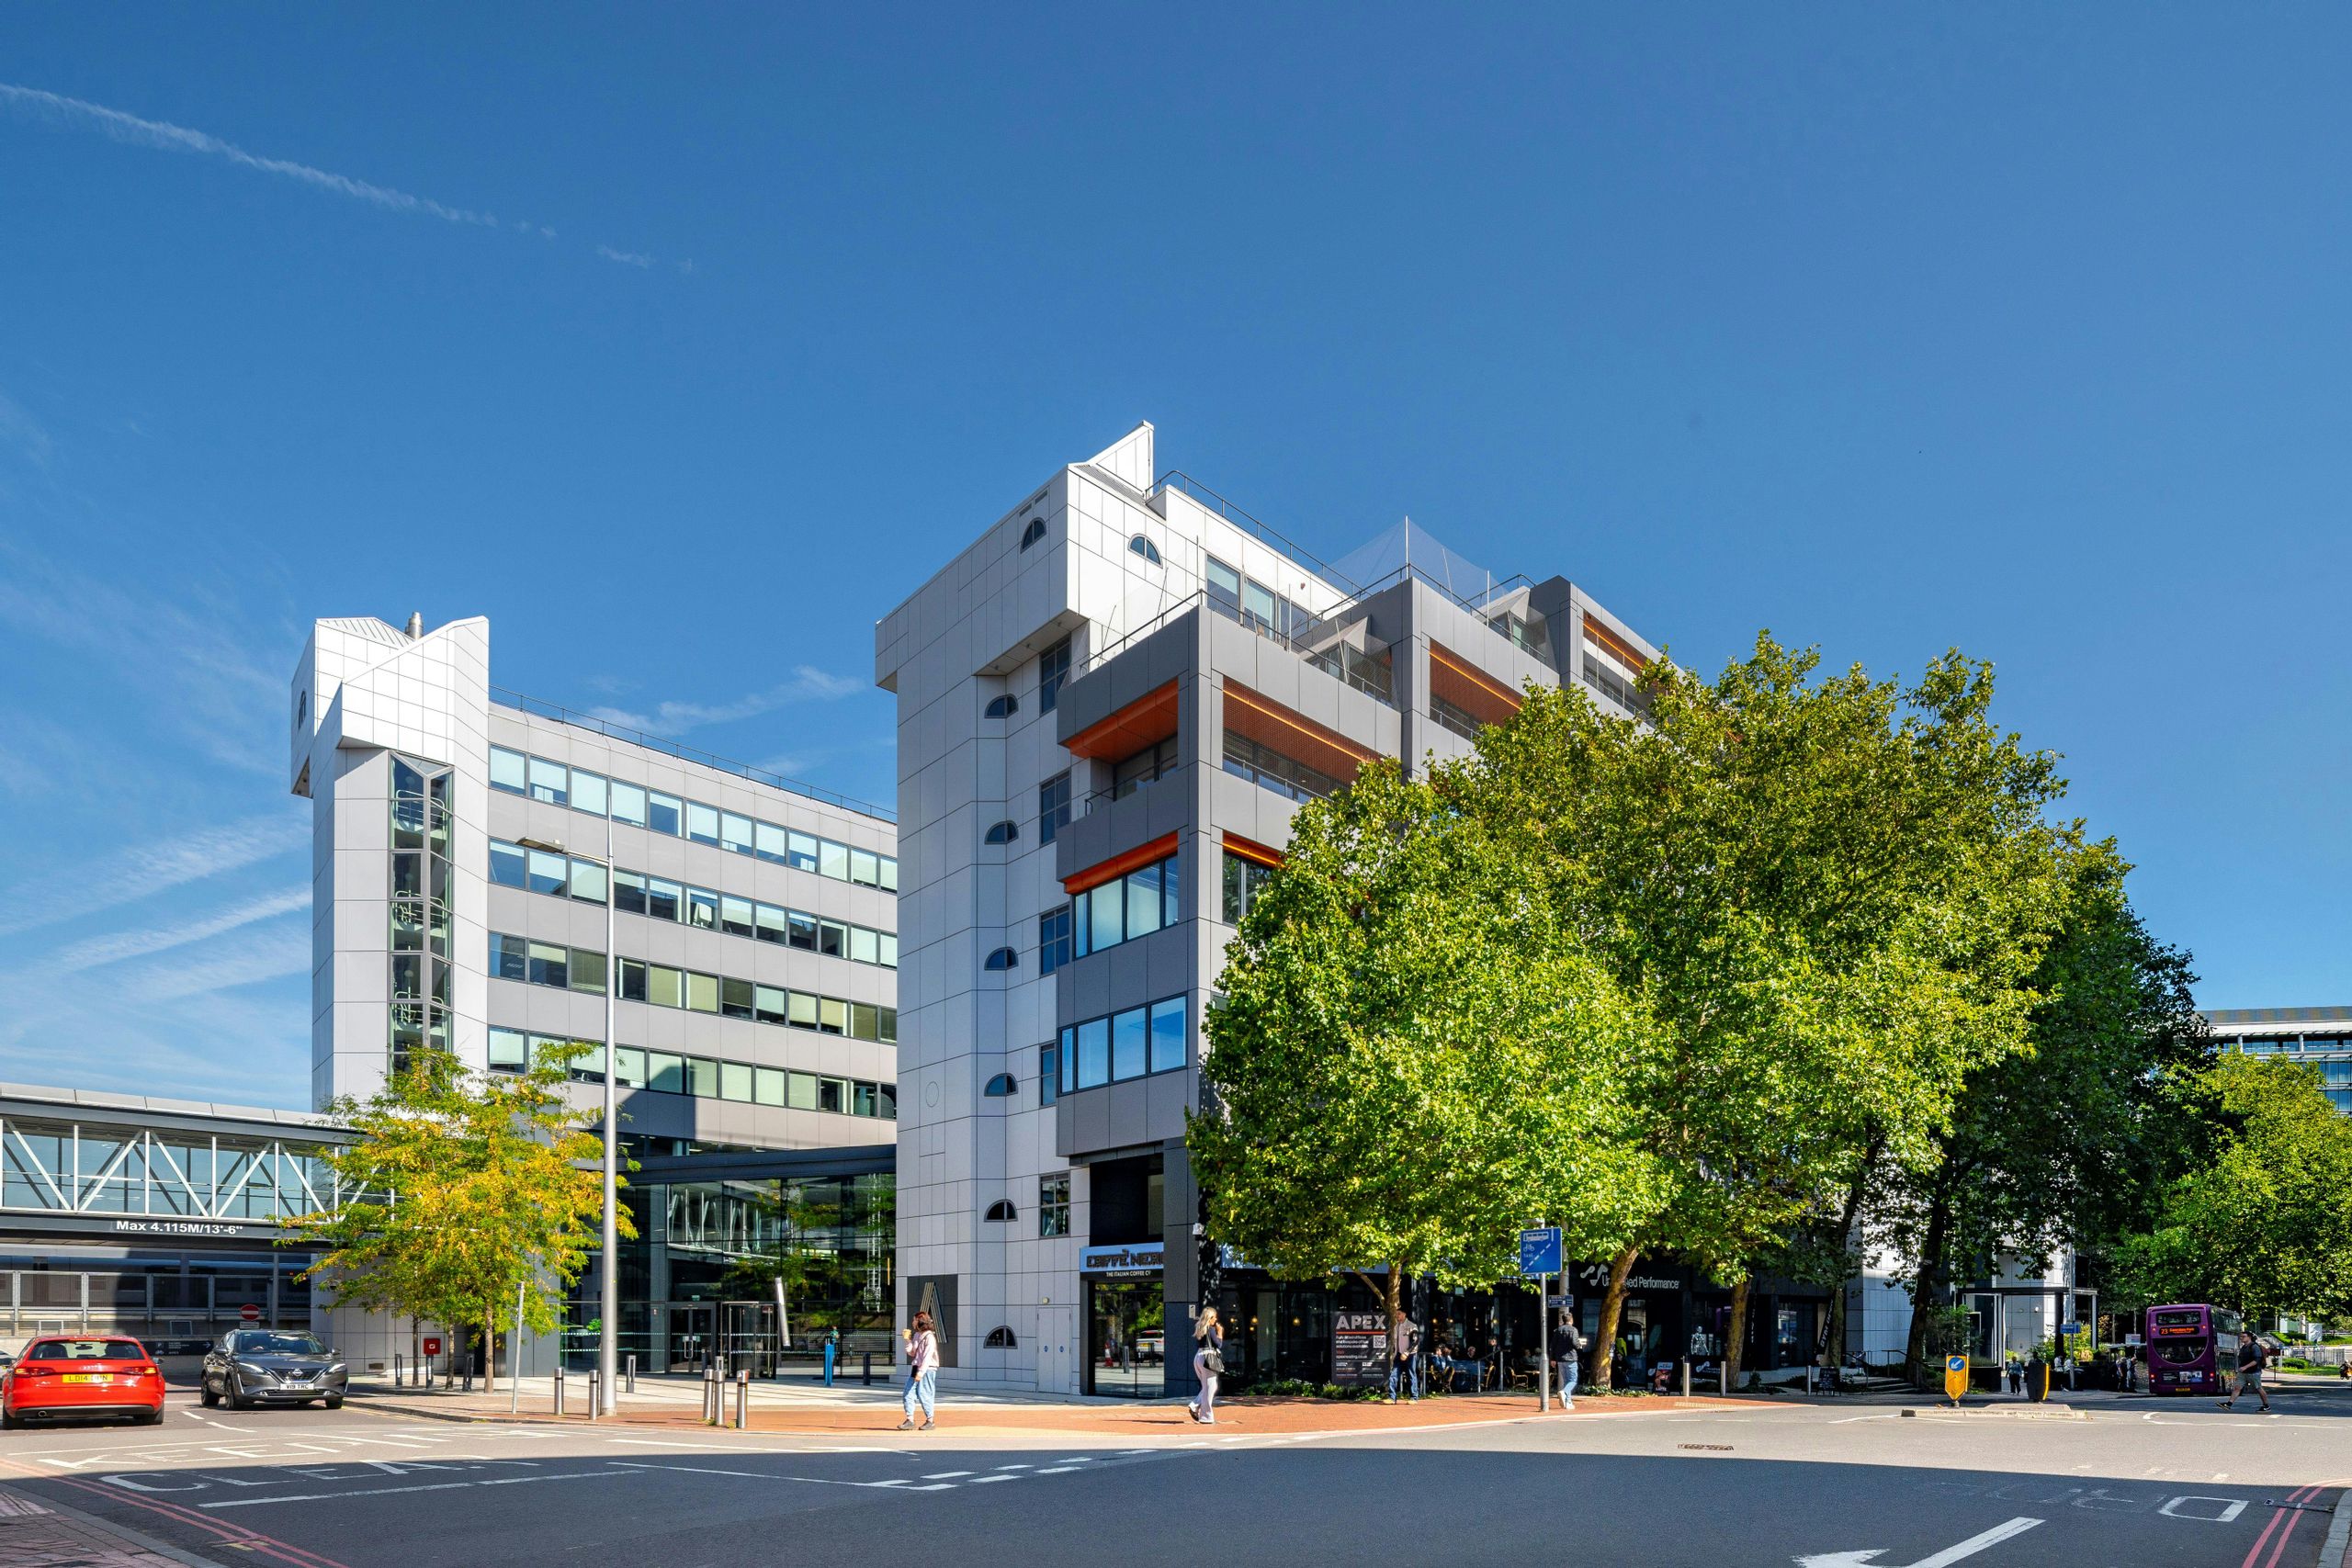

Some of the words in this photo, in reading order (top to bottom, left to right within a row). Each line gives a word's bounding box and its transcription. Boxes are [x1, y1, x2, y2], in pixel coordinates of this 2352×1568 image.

[117, 1221, 146, 1231] Max
[1130, 1252, 1163, 1266] NER
[1638, 1276, 1679, 1290] Performance
[1336, 1314, 1386, 1330] APEX
[37, 1441, 365, 1470] KEEP
